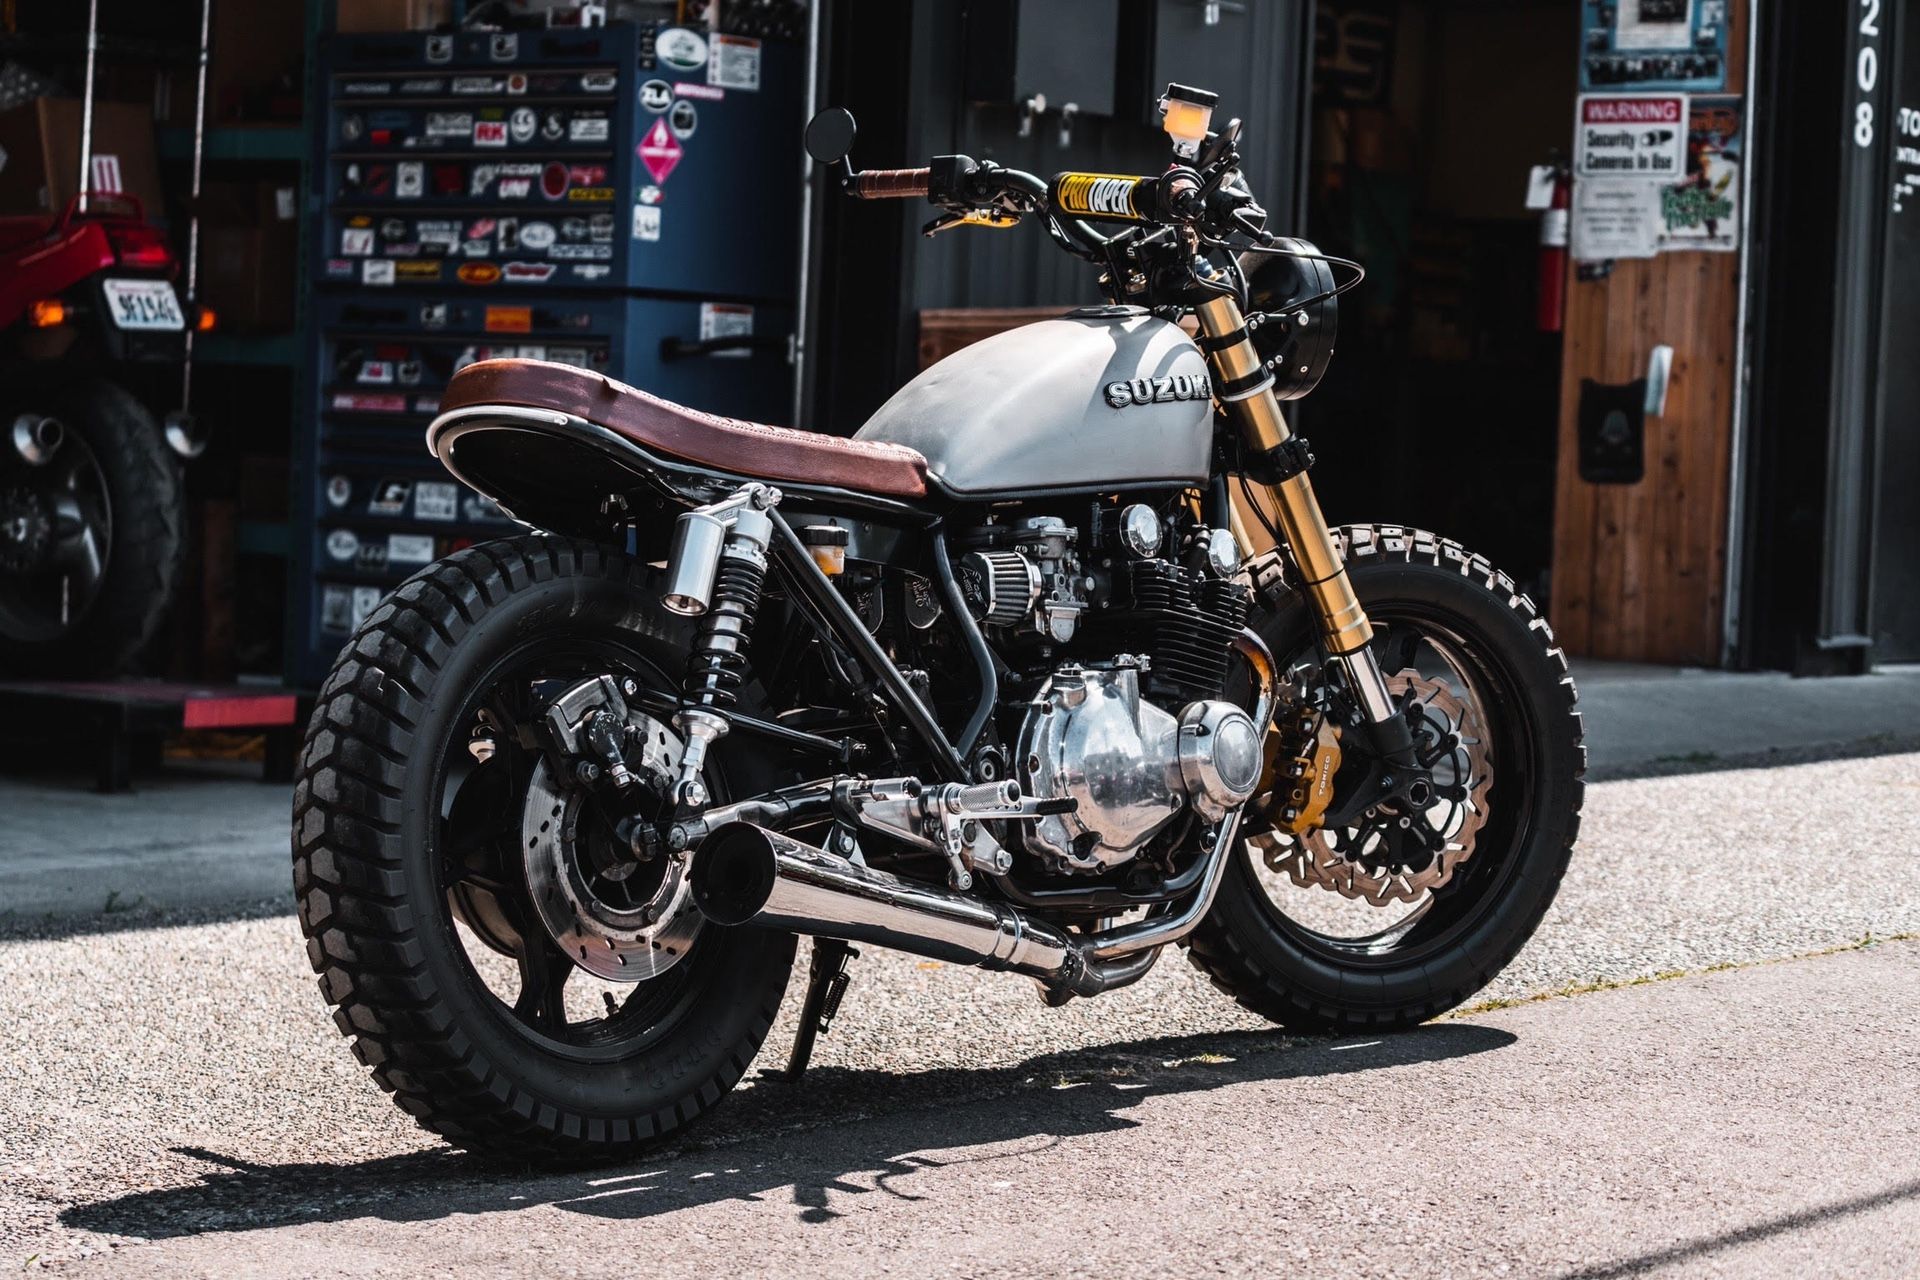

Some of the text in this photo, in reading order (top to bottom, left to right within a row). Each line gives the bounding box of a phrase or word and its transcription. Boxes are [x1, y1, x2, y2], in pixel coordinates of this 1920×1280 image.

[1588, 102, 1677, 119] WARNING
[1587, 129, 1635, 150] Security
[1586, 152, 1634, 169] Cameras
[1652, 152, 1672, 169] Use
[1061, 176, 1135, 216] PROTAPER
